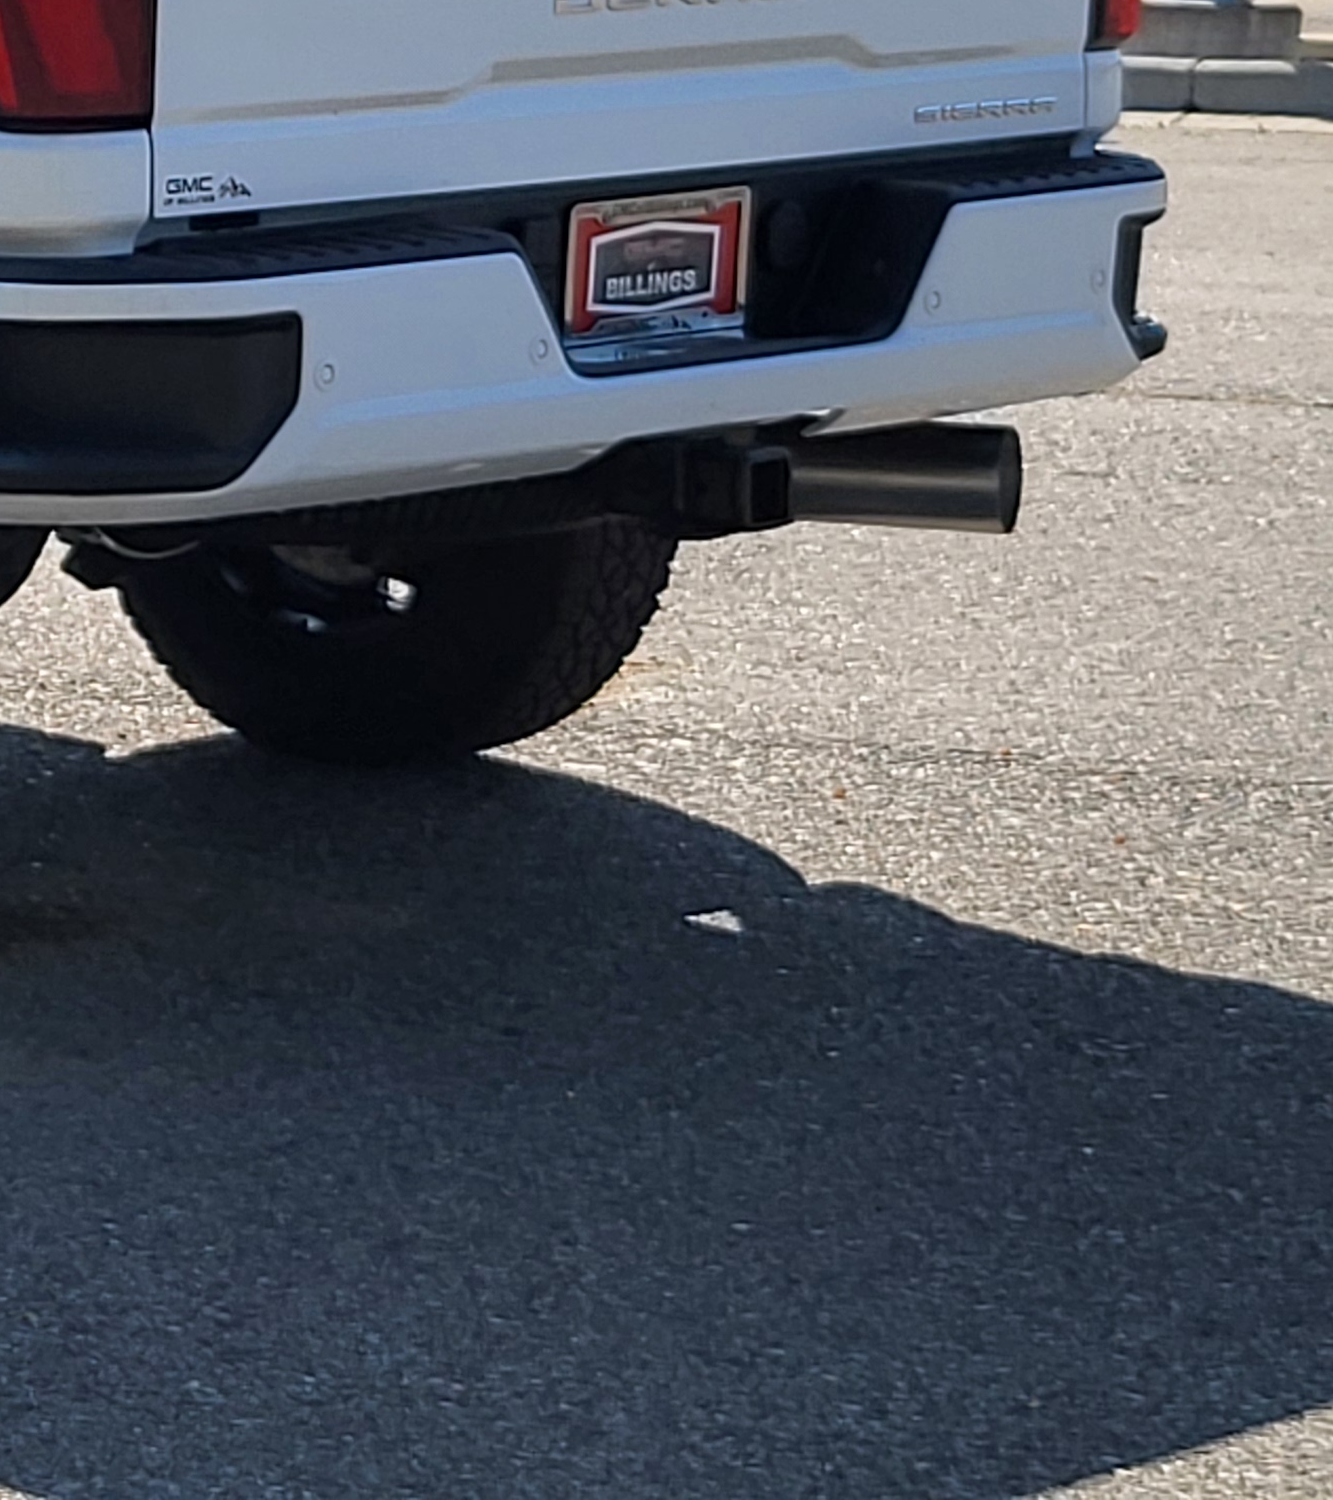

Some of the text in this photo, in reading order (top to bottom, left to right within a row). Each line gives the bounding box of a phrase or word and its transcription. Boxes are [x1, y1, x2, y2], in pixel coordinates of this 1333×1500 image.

[913, 95, 1060, 124] SIERRA
[165, 176, 213, 195] GMC
[605, 269, 697, 299] BILLINGS
